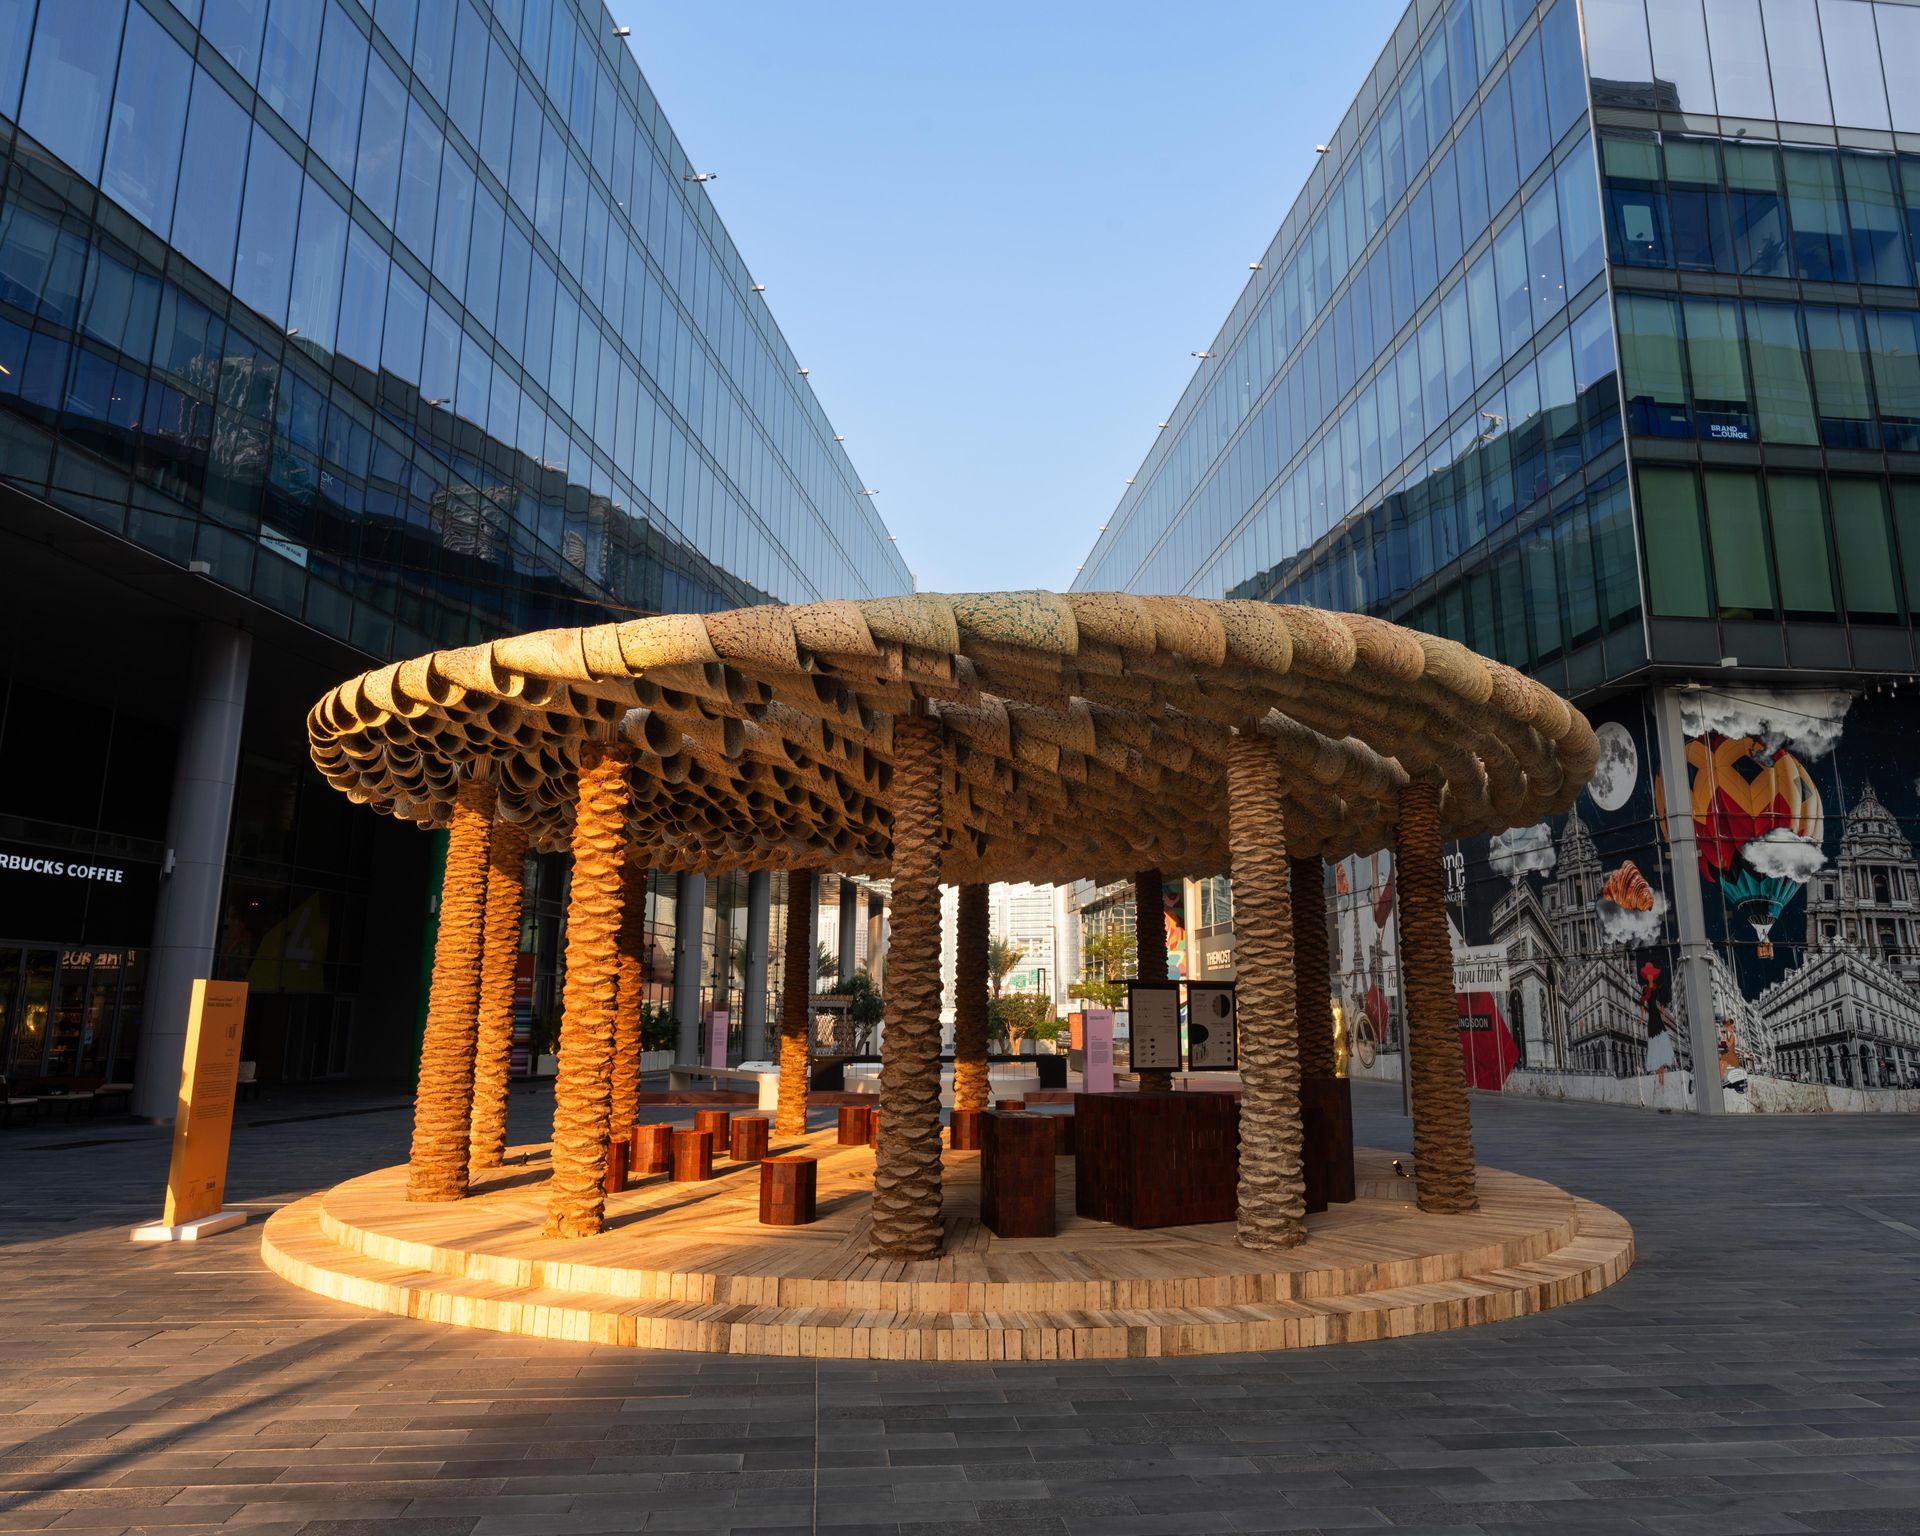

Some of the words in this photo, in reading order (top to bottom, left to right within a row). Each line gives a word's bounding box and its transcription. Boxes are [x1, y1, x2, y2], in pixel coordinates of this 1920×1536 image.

[67, 864, 124, 883] COFFEE
[1459, 970, 1475, 990] you
[1477, 962, 1502, 982] think
[1470, 1018, 1489, 1028] SOON
